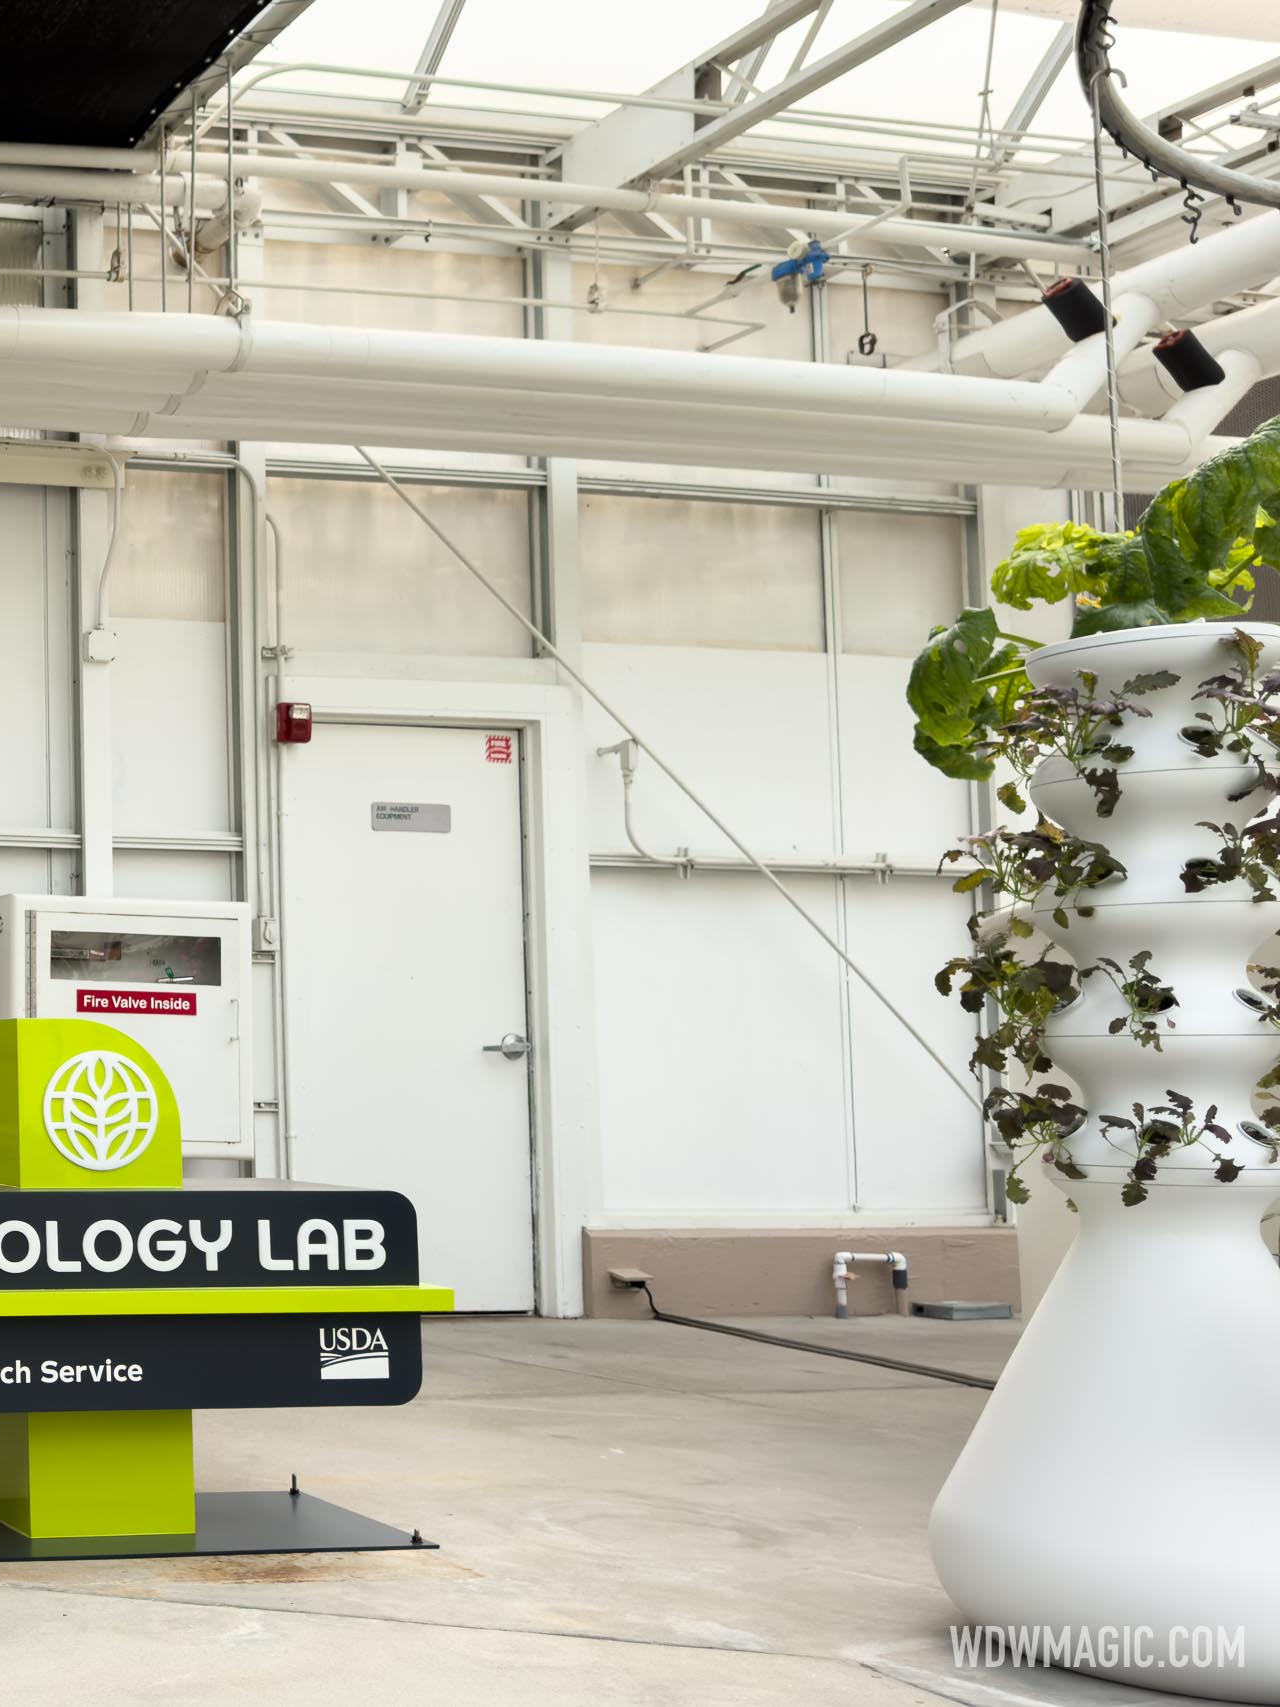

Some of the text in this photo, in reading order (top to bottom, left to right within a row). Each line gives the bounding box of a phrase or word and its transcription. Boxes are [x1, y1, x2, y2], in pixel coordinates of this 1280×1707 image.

[83, 995, 191, 1011] Fire Valve Inside
[258, 1218, 387, 1271] LAB
[319, 1327, 389, 1351] USDA
[40, 1358, 143, 1384] Service
